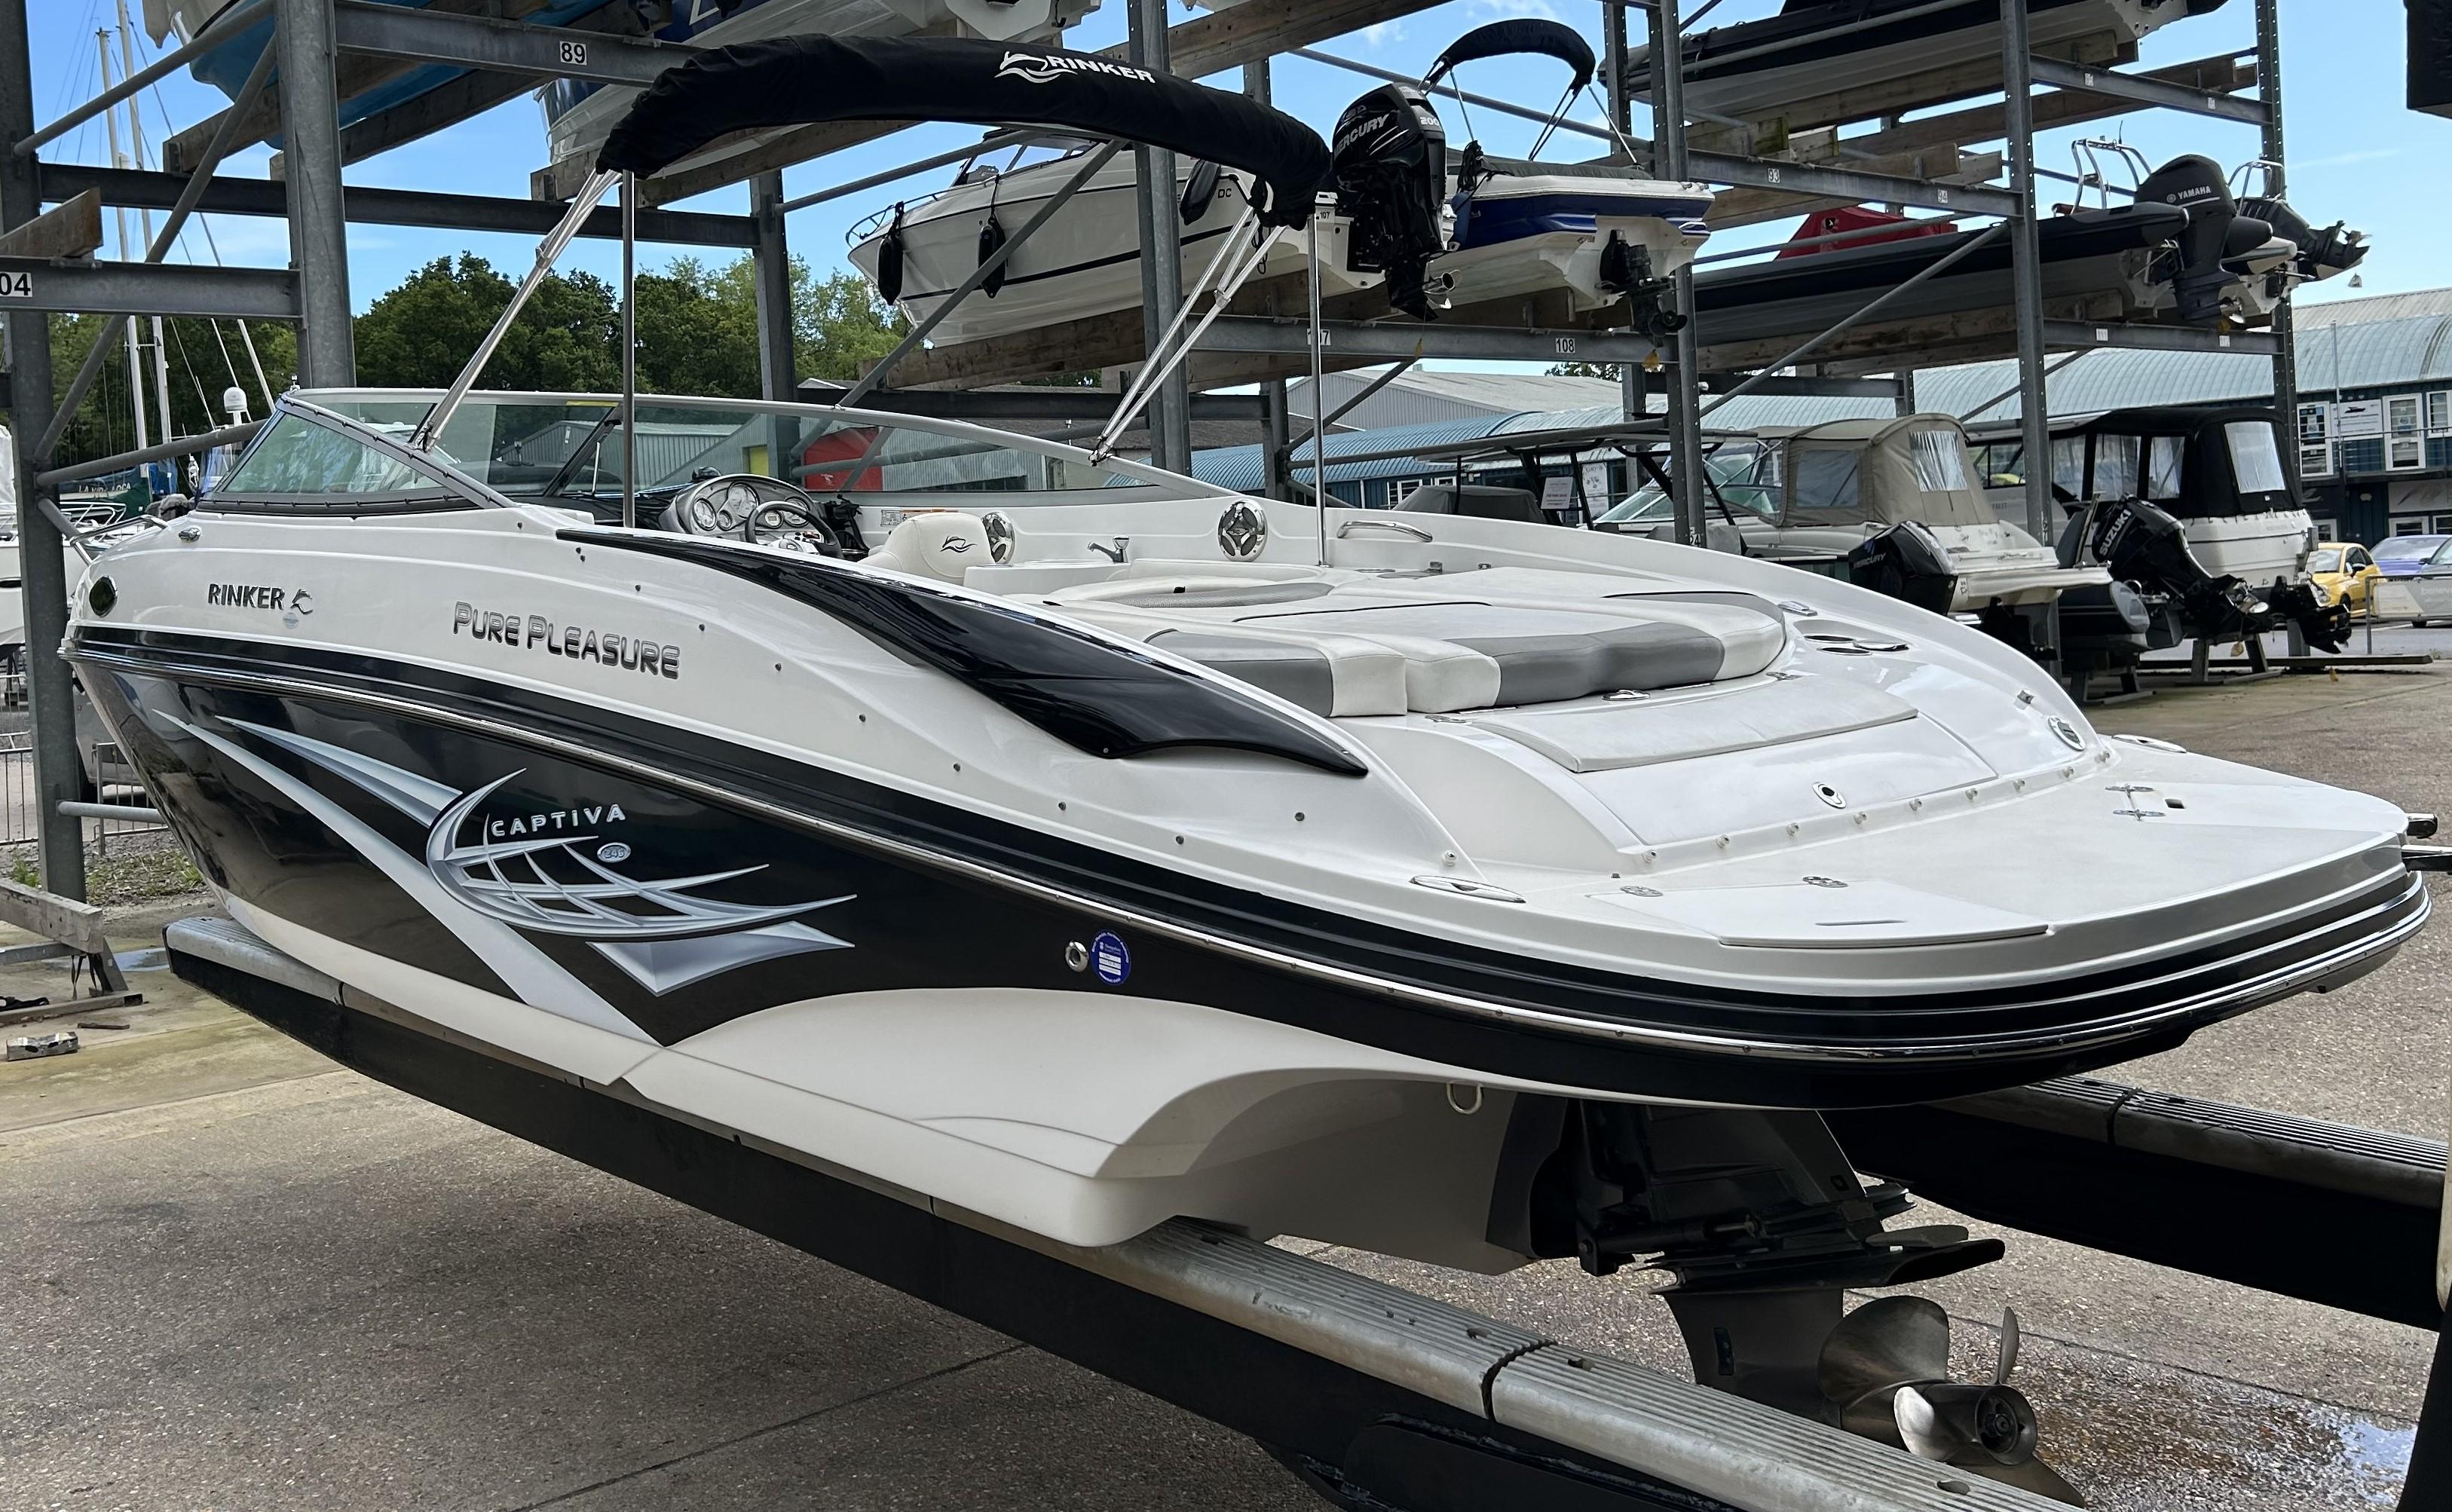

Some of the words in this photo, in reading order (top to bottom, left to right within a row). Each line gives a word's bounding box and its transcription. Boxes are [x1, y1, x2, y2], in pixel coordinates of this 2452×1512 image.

[562, 43, 585, 63] 89
[1046, 55, 1156, 84] RINKER
[1420, 117, 1439, 126] 200
[1769, 170, 1779, 182] 93
[1218, 188, 1232, 198] DC
[2178, 185, 2211, 200] YAMAHA
[1557, 338, 1575, 353] 108
[2099, 509, 2132, 556] SUZUKI
[208, 583, 285, 611] RINKER
[491, 803, 626, 837] CAPTIVA
